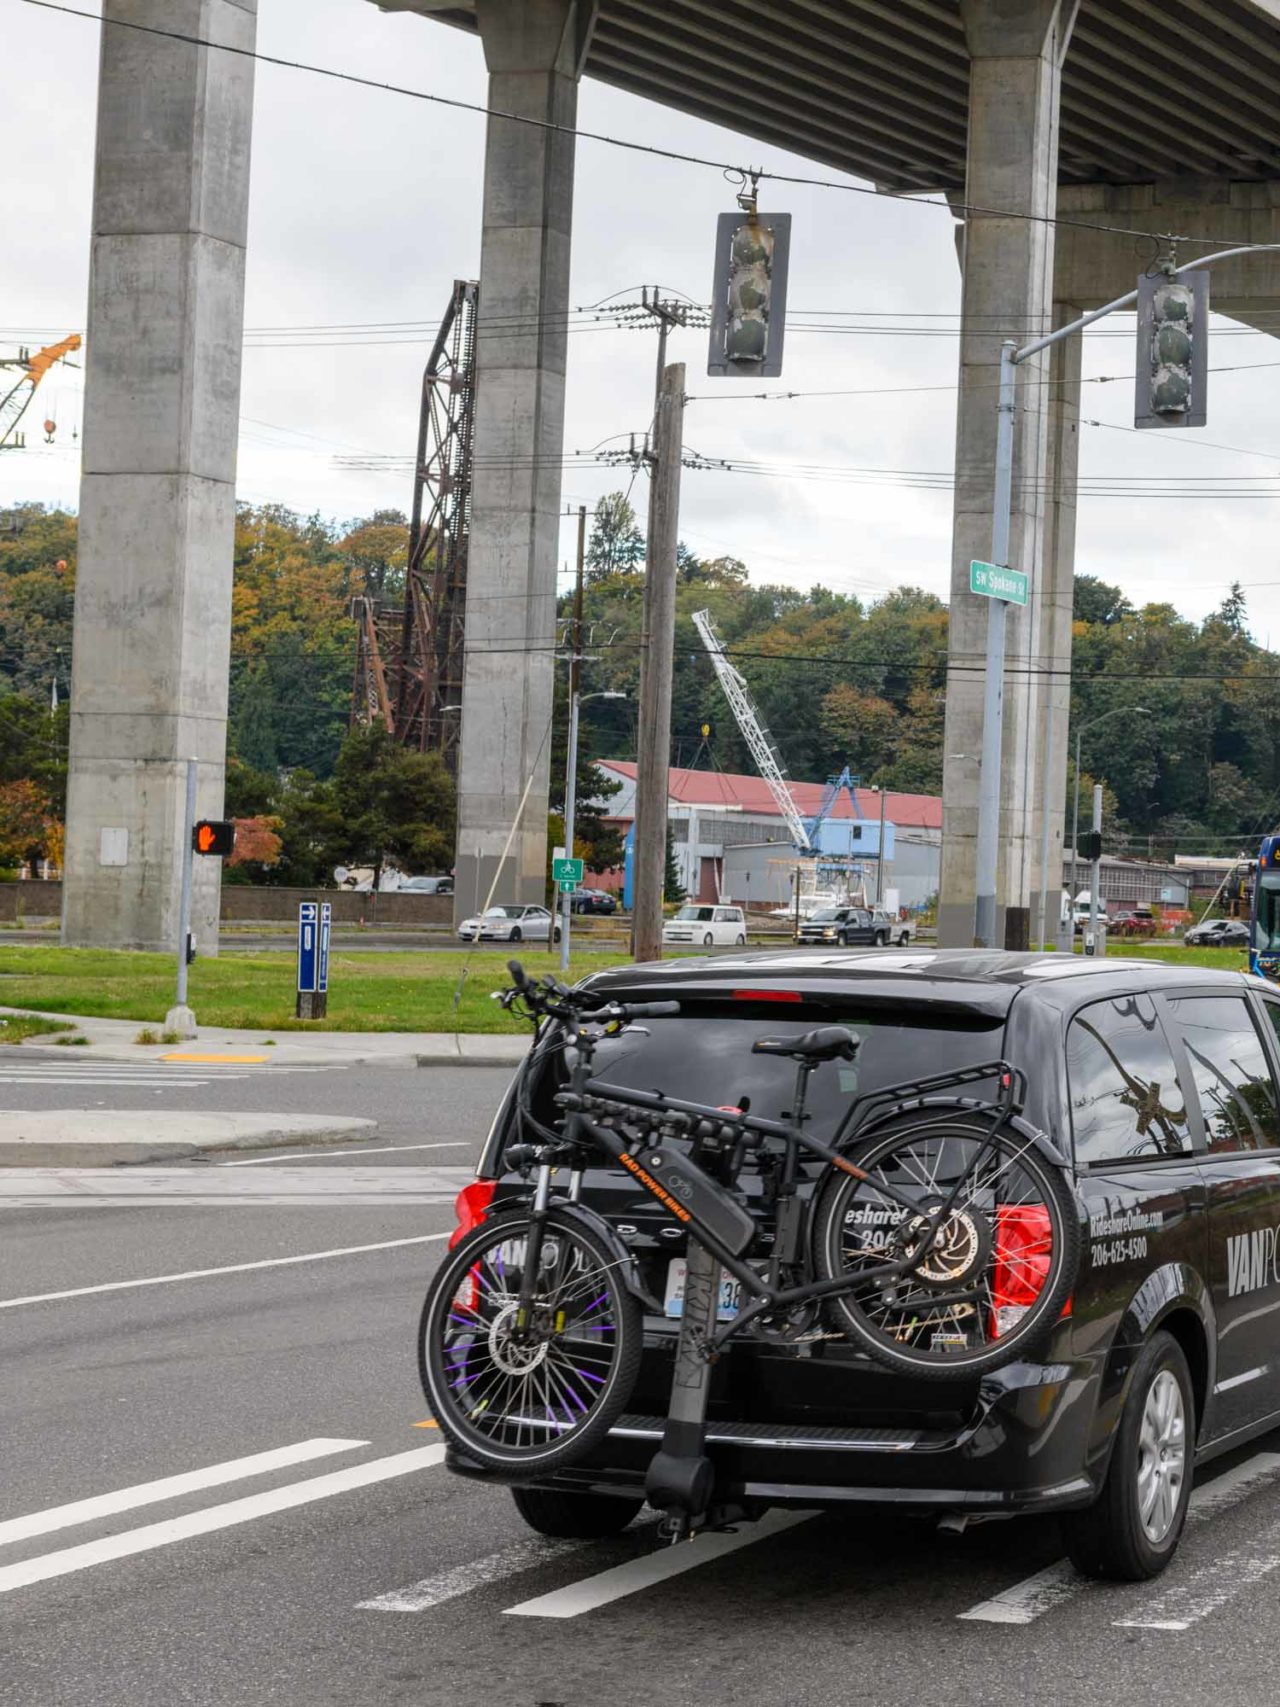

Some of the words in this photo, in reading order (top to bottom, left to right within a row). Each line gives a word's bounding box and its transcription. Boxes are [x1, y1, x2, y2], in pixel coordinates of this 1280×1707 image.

[988, 571, 1016, 594] Spokane
[618, 1153, 640, 1171] RAD
[635, 1169, 669, 1200] POWER
[664, 1197, 691, 1222] BIKES
[1090, 1207, 1163, 1238] RideshareOnline.com
[1091, 1236, 1148, 1268] 206-625-4500
